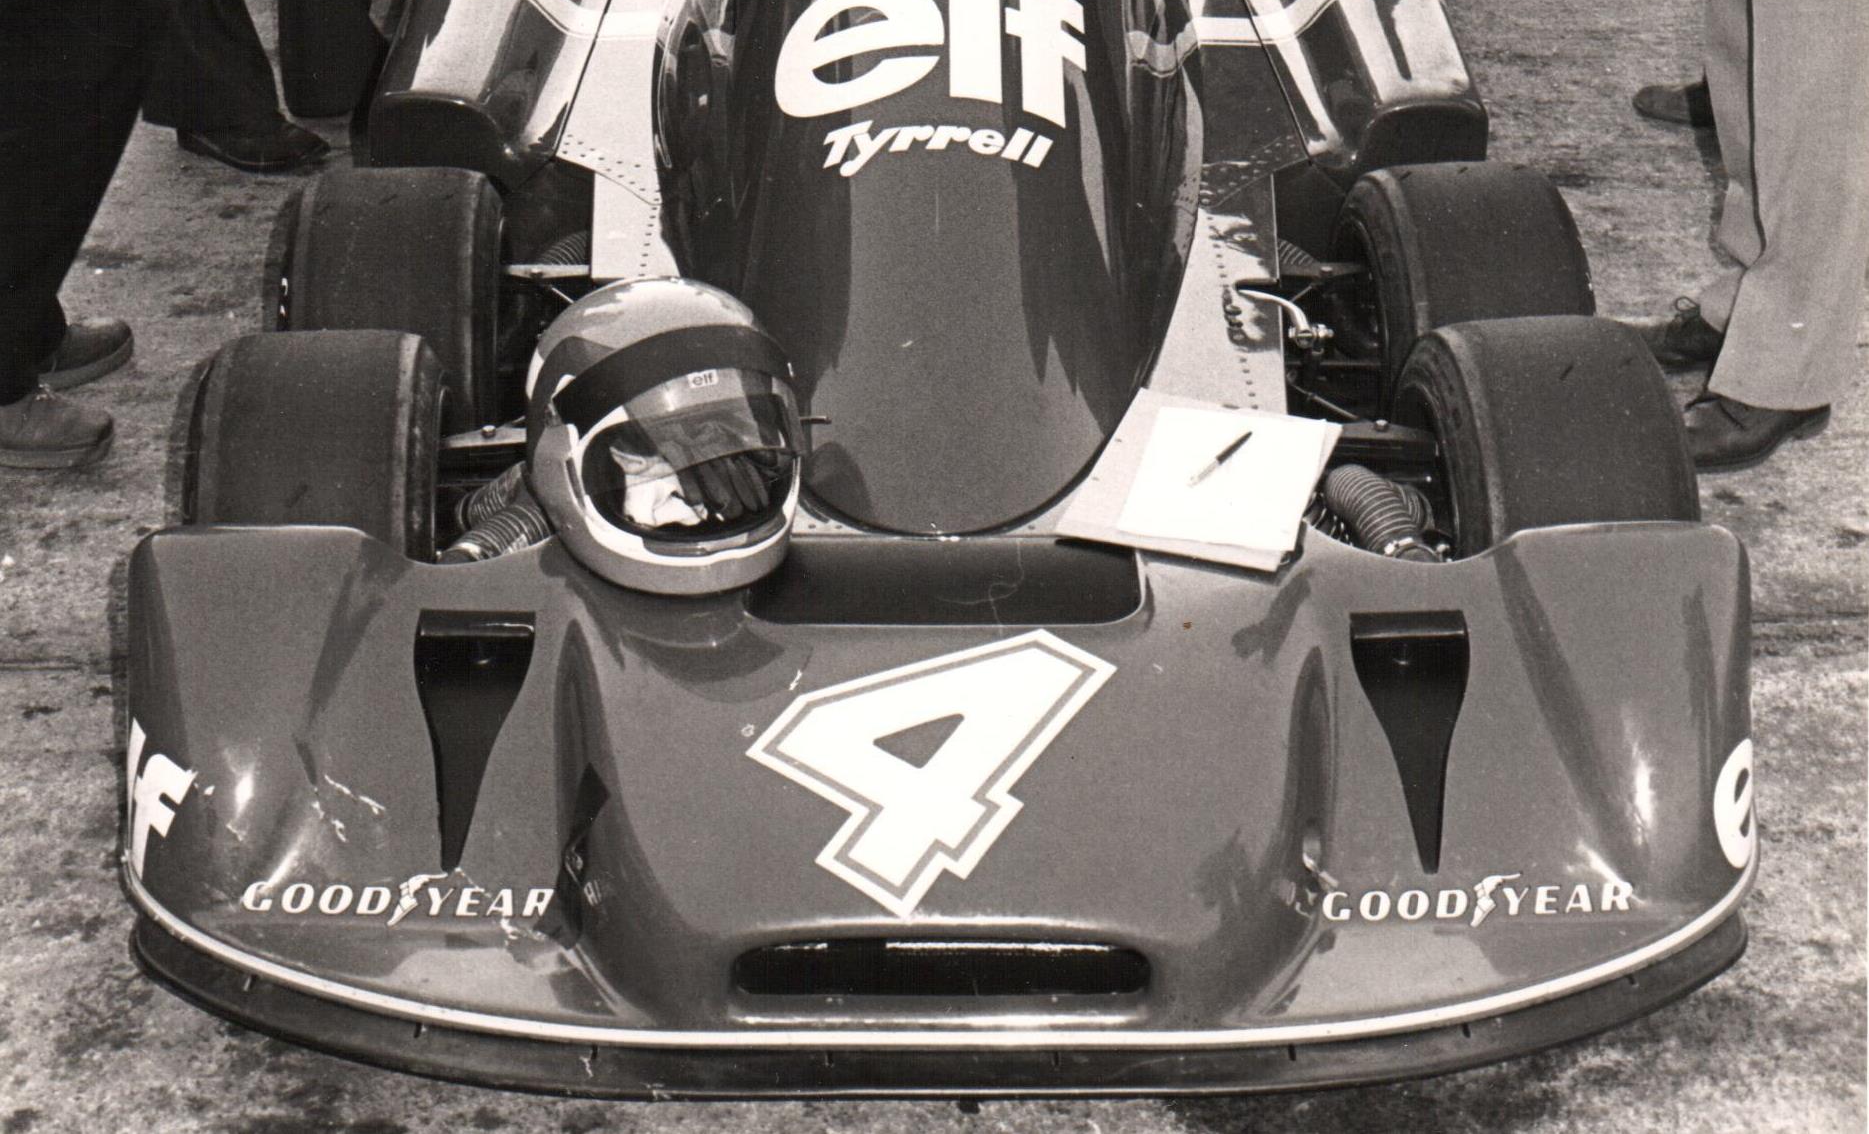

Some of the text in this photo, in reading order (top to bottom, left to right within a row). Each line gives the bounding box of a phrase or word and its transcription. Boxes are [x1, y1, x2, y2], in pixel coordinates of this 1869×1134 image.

[822, 120, 1054, 177] Tyrrell
[692, 372, 714, 386] elf
[745, 628, 1118, 918] 4
